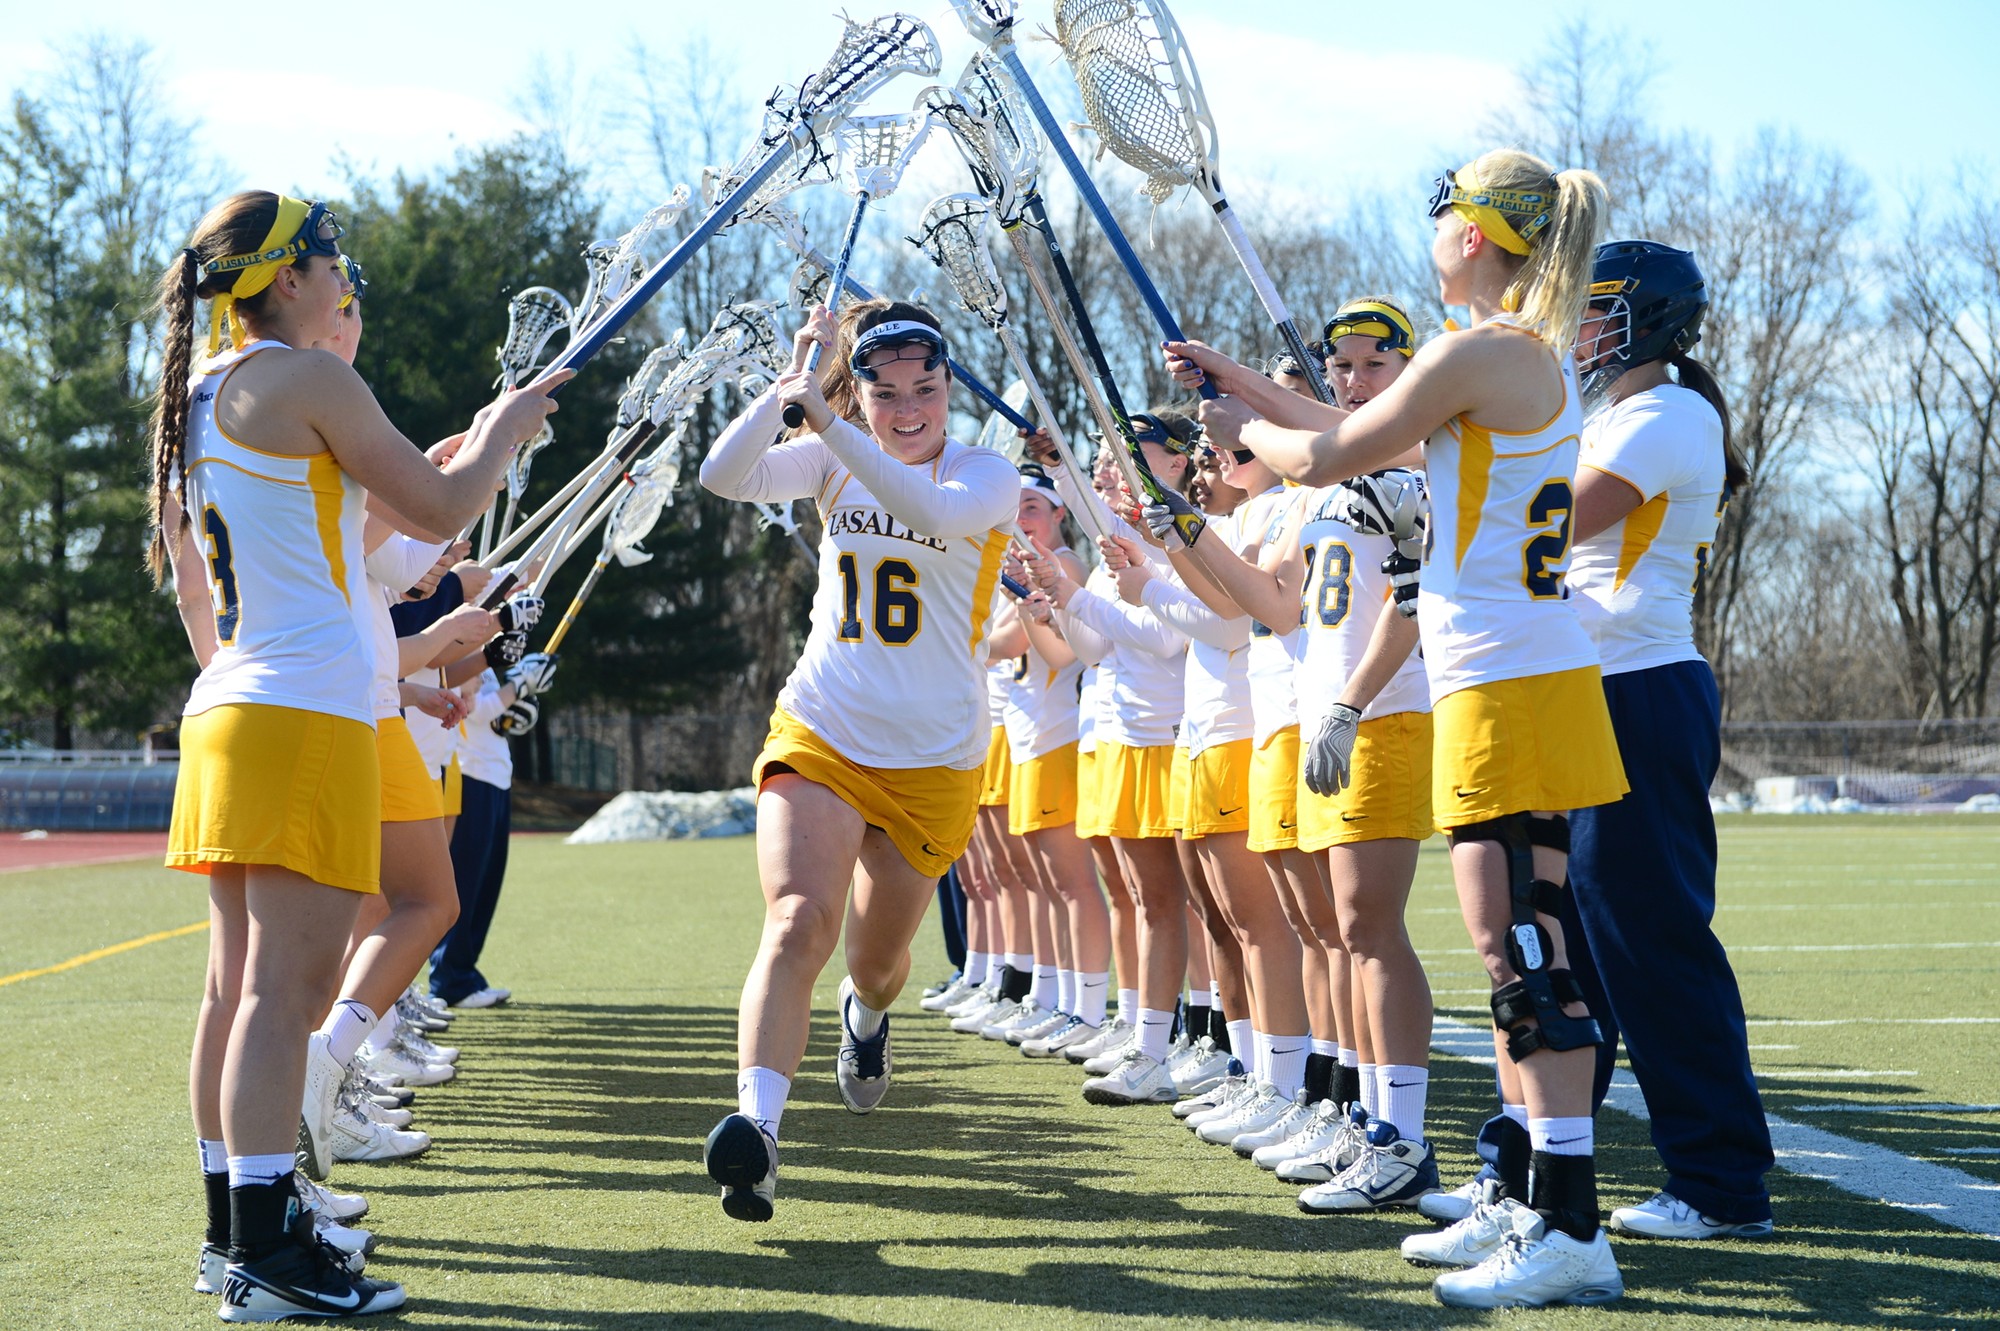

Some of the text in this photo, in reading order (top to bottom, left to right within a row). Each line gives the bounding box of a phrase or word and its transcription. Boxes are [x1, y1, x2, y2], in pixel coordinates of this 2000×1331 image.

[1492, 199, 1538, 213] LASALLE
[220, 254, 262, 270] LASALLE
[1415, 477, 1424, 493] STX
[837, 551, 922, 647] 16
